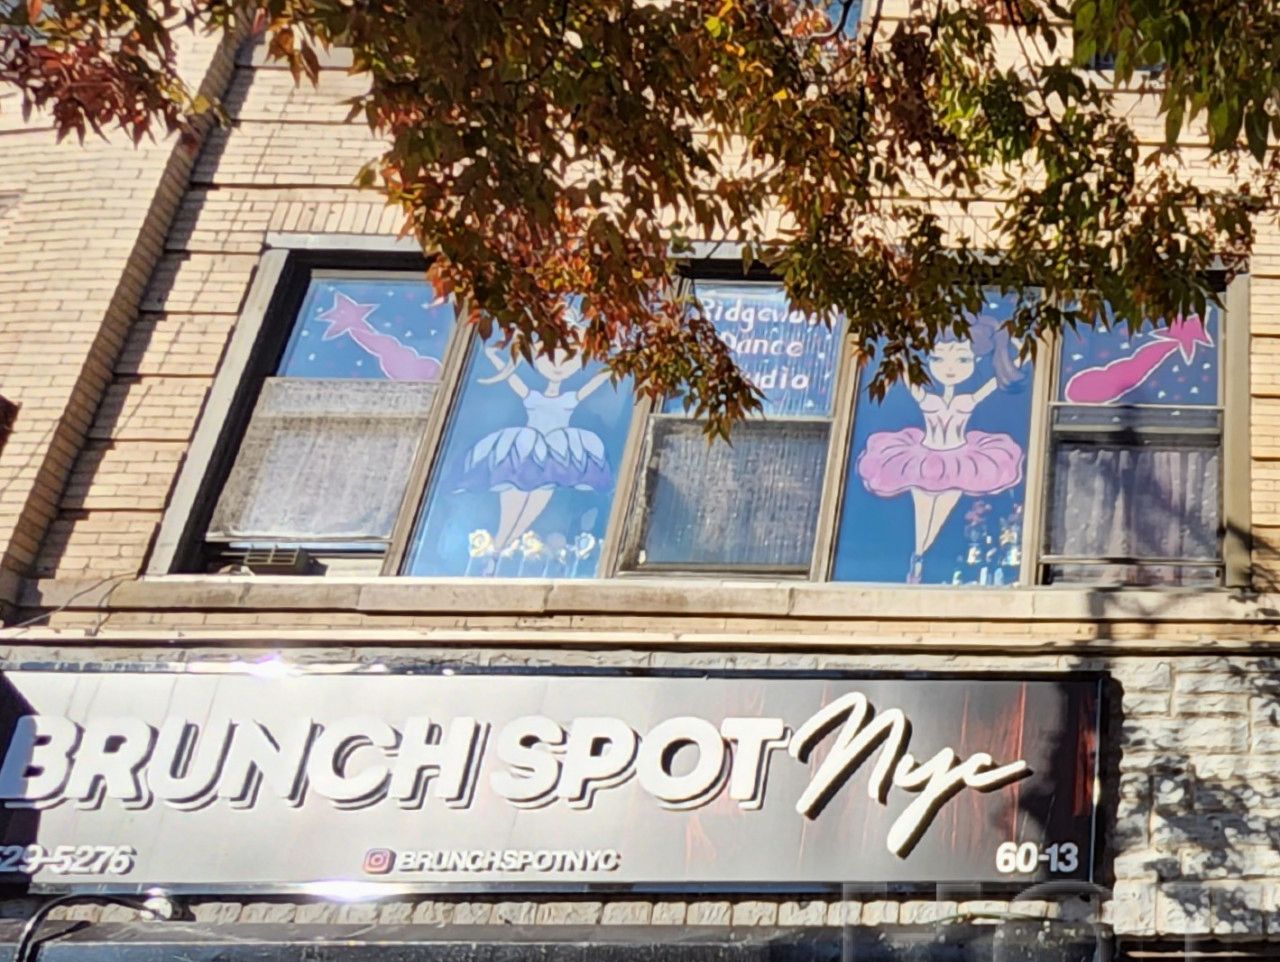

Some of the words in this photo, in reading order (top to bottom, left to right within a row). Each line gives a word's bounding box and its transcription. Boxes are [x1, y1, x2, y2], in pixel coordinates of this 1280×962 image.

[0, 714, 490, 809] BRUNCH
[492, 714, 790, 810] SPOT
[0, 844, 136, 875] 29-5276
[400, 848, 621, 873] BRUNCHSPOTNYC
[994, 841, 1079, 873] 60-13
